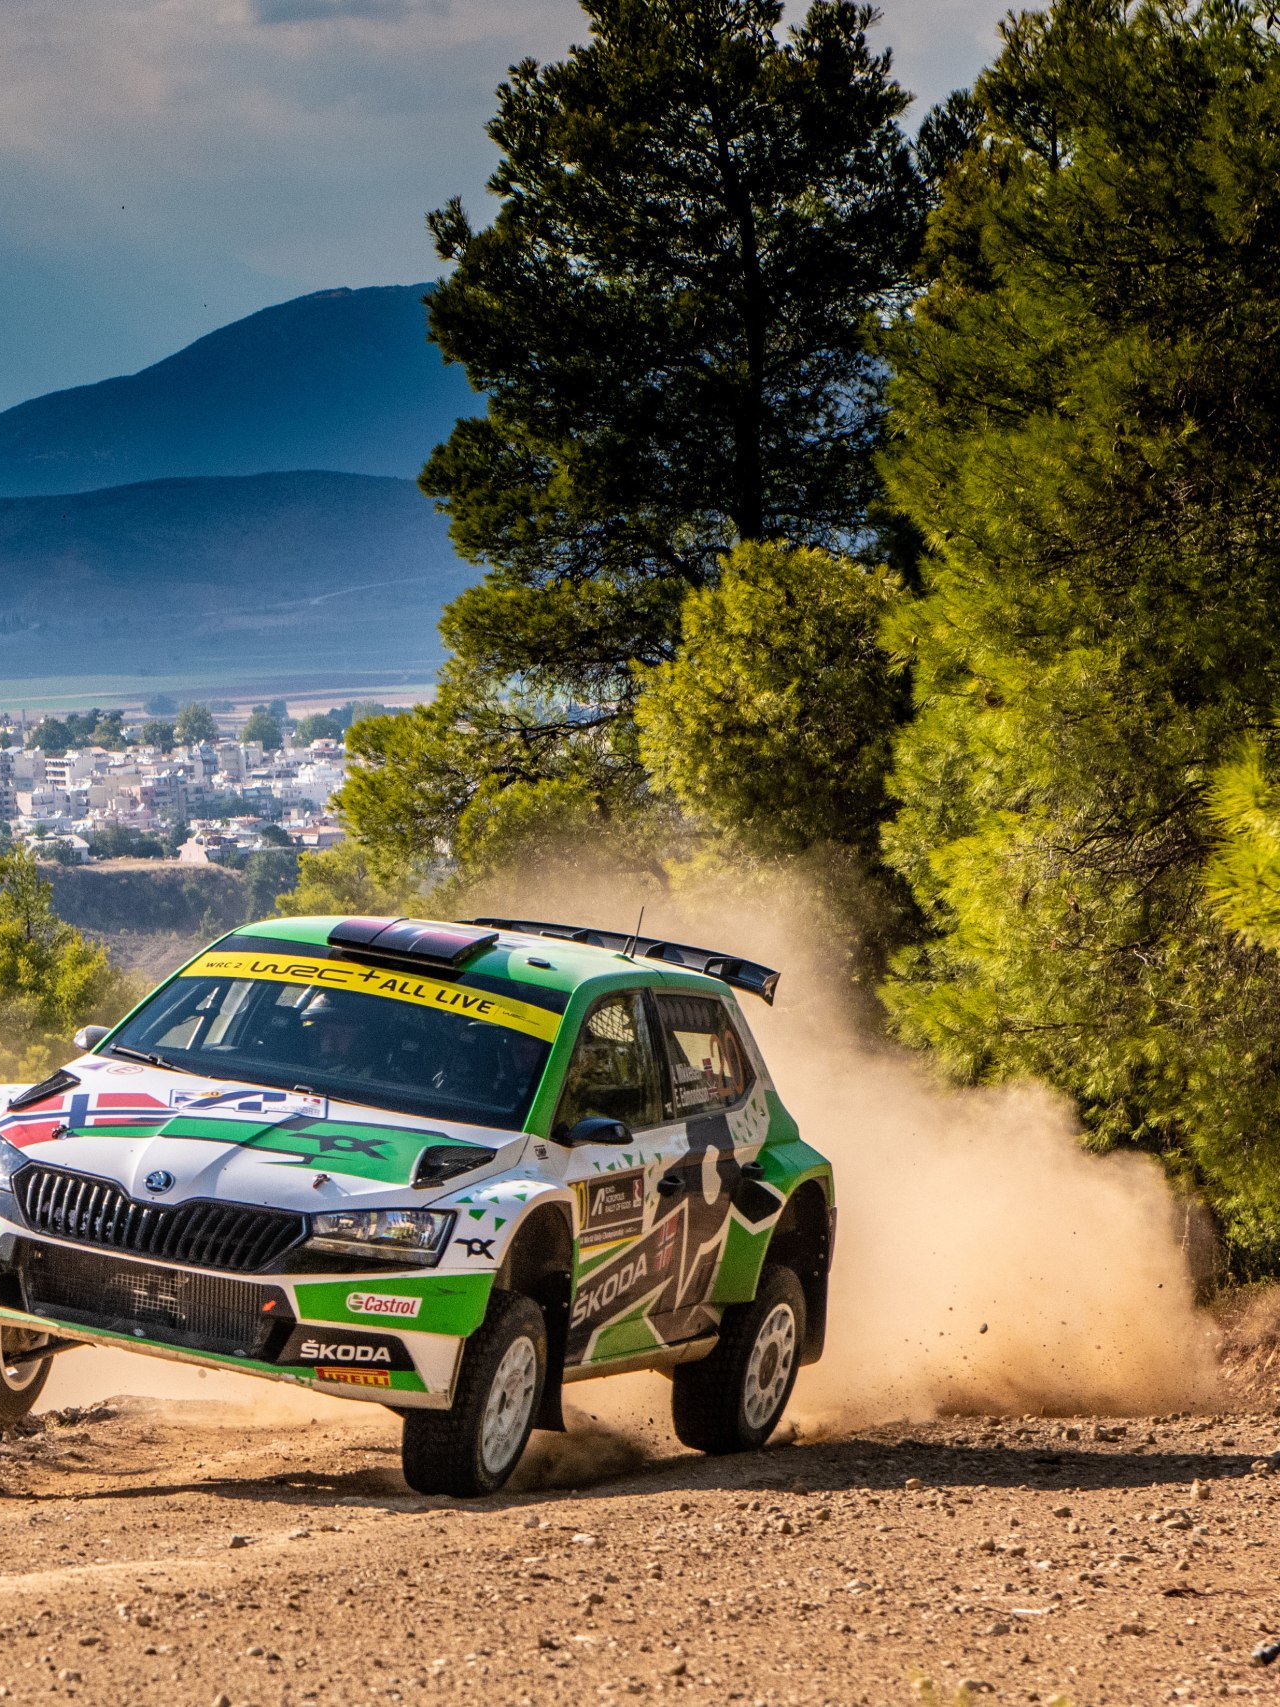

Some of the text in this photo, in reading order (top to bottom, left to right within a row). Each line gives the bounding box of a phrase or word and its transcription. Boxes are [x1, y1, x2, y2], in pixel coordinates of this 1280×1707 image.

[205, 961, 232, 969] WRC
[378, 978, 427, 999] ALL
[434, 990, 496, 1014] LIVE
[709, 1029, 745, 1097] 20
[570, 1252, 648, 1329] ŠKODA
[363, 1296, 417, 1315] Castrol
[300, 1339, 392, 1362] ŠKODA
[316, 1367, 389, 1386] PIRELLI
